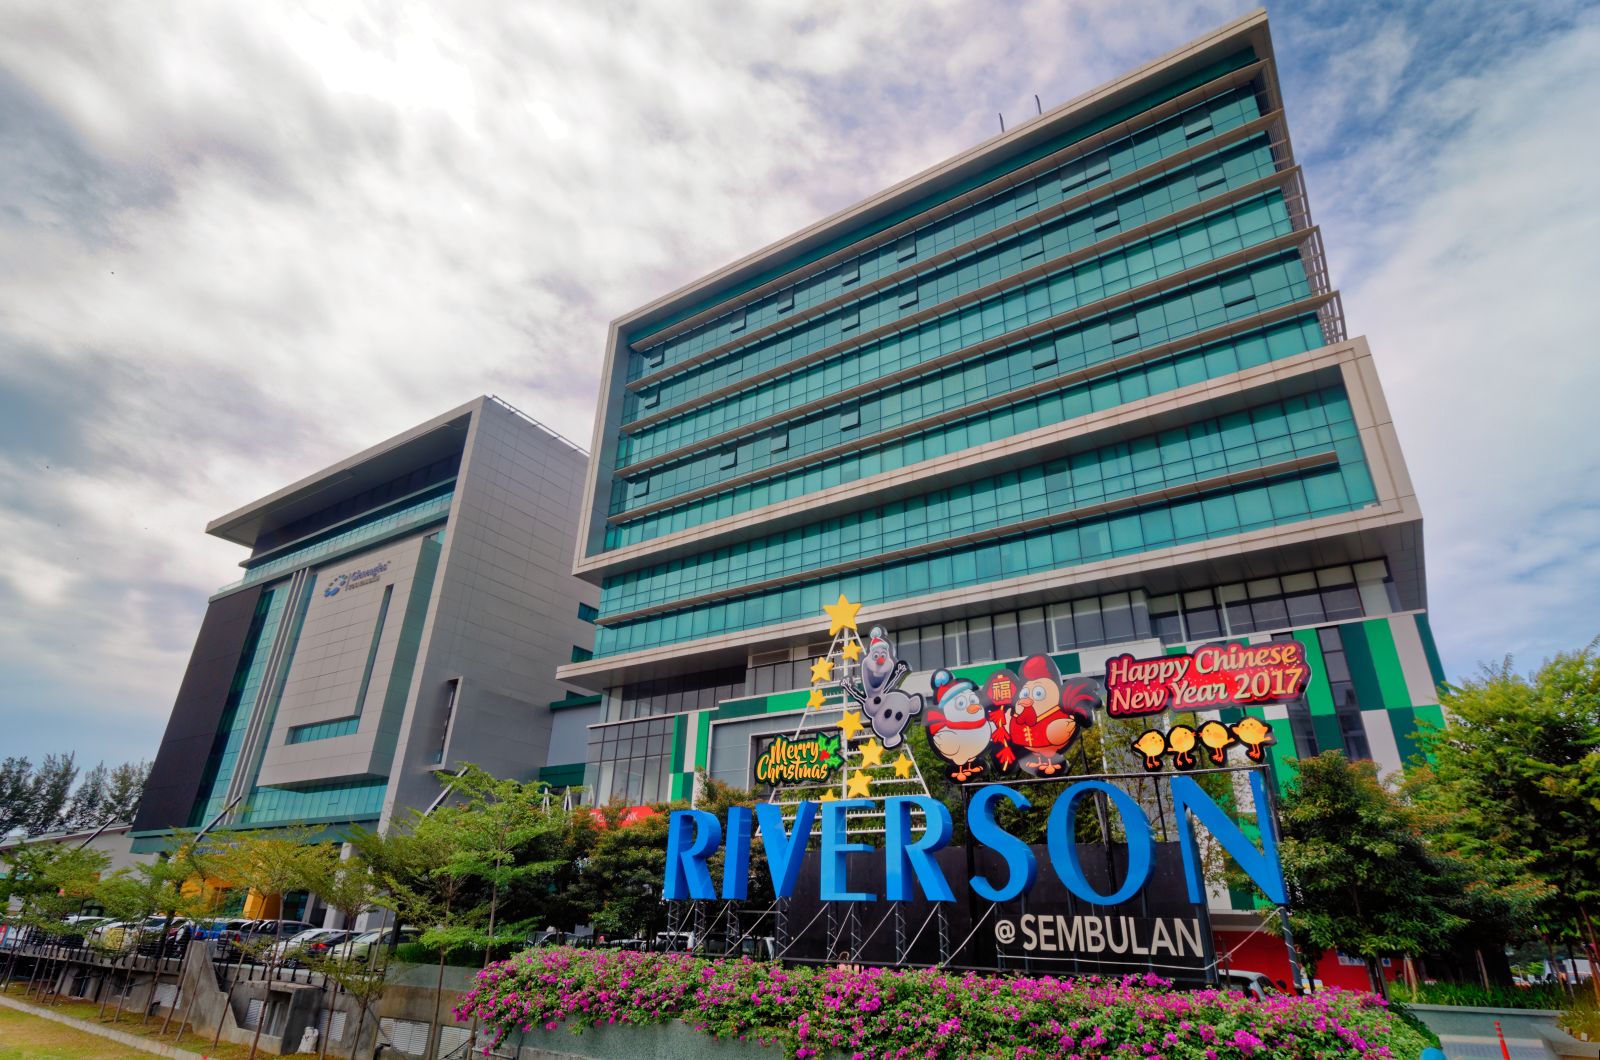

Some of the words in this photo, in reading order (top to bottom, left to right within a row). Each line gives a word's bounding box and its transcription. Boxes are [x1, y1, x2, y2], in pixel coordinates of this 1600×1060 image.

[1110, 657, 1190, 686] Happy
[1195, 645, 1297, 674] Chinese
[992, 680, 1011, 700] 福
[1112, 688, 1165, 712] New
[1171, 681, 1228, 705] Year
[1234, 668, 1302, 700] 2017
[757, 755, 828, 783] Christmas
[770, 737, 819, 766] Merry
[664, 771, 1289, 906] RIVERSON
